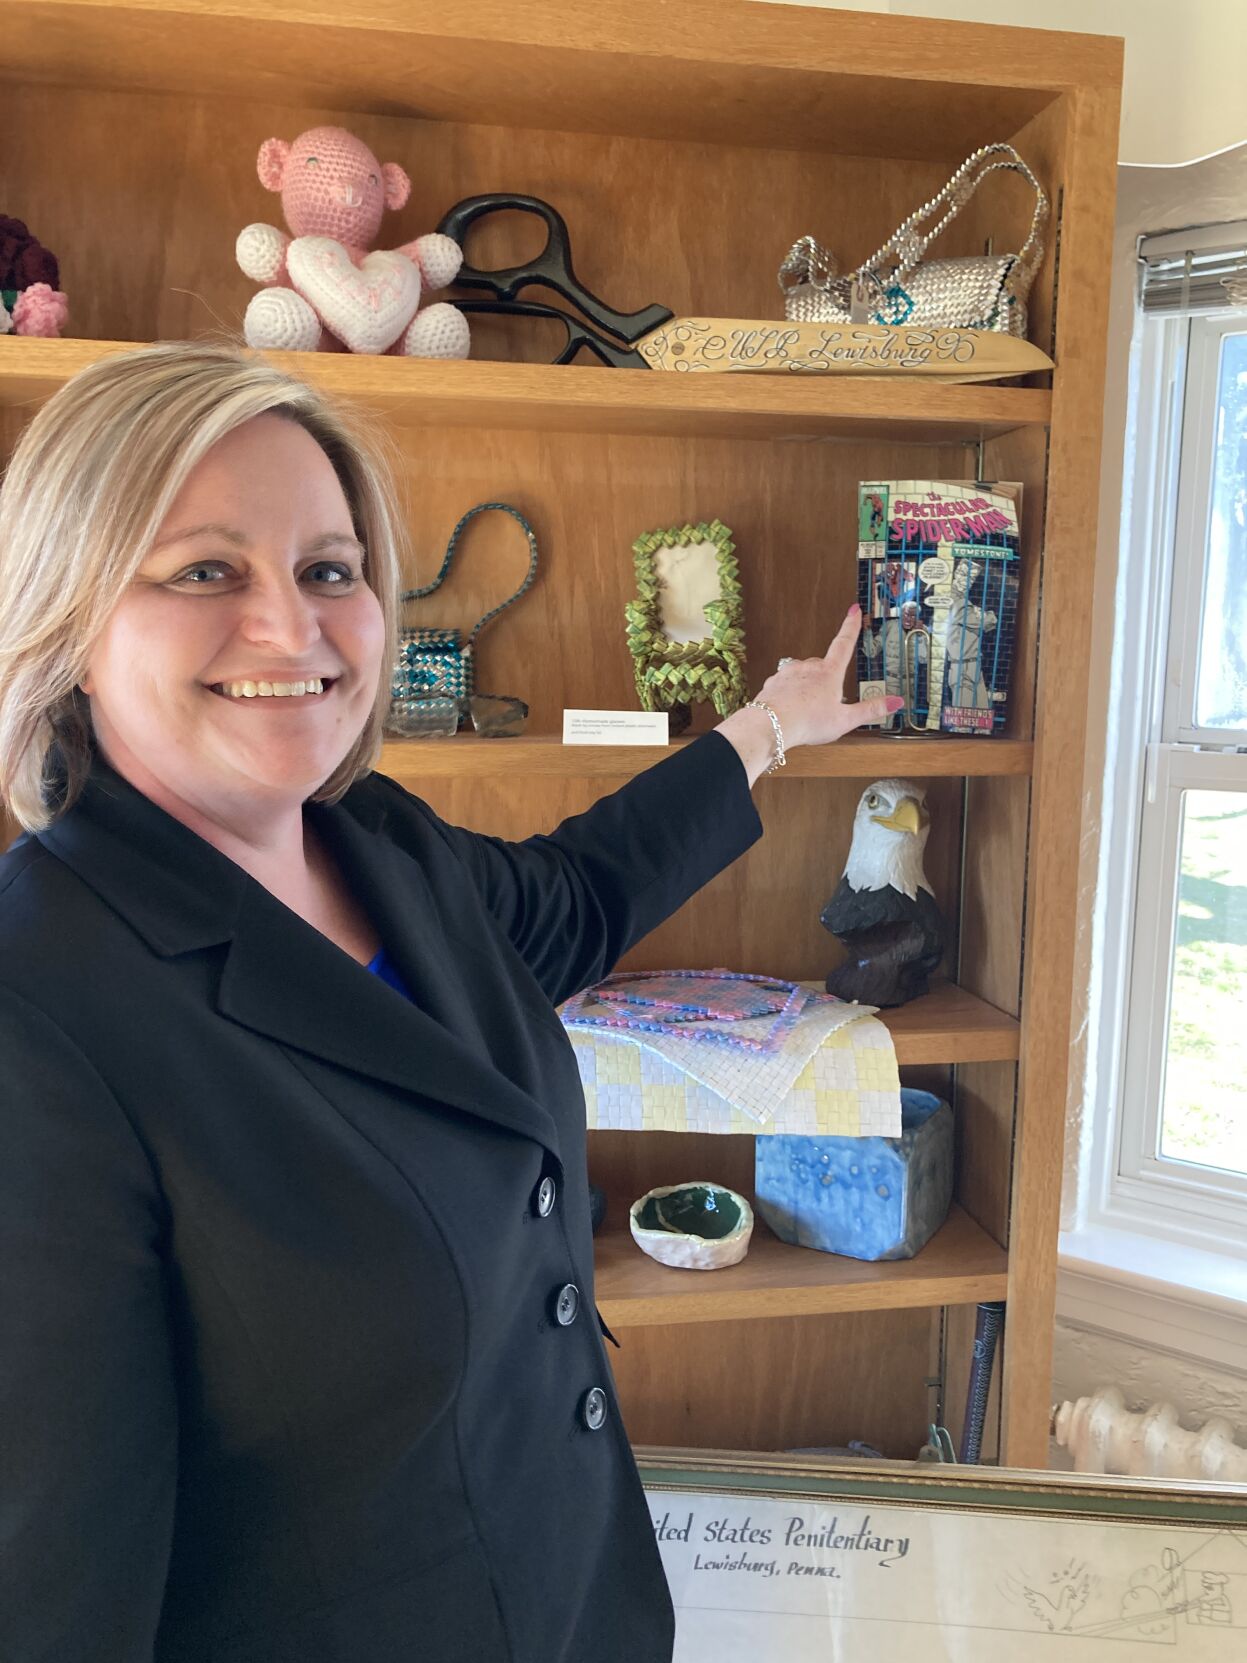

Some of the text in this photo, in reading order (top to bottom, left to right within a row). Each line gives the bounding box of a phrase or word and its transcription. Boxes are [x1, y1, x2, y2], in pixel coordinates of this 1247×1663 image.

[809, 329, 934, 368] Lewisburg
[894, 498, 994, 518] SPECTACULAR
[653, 1512, 910, 1567] ited States Penitentiary
[693, 1551, 842, 1579] Lewisburg, Penna.
